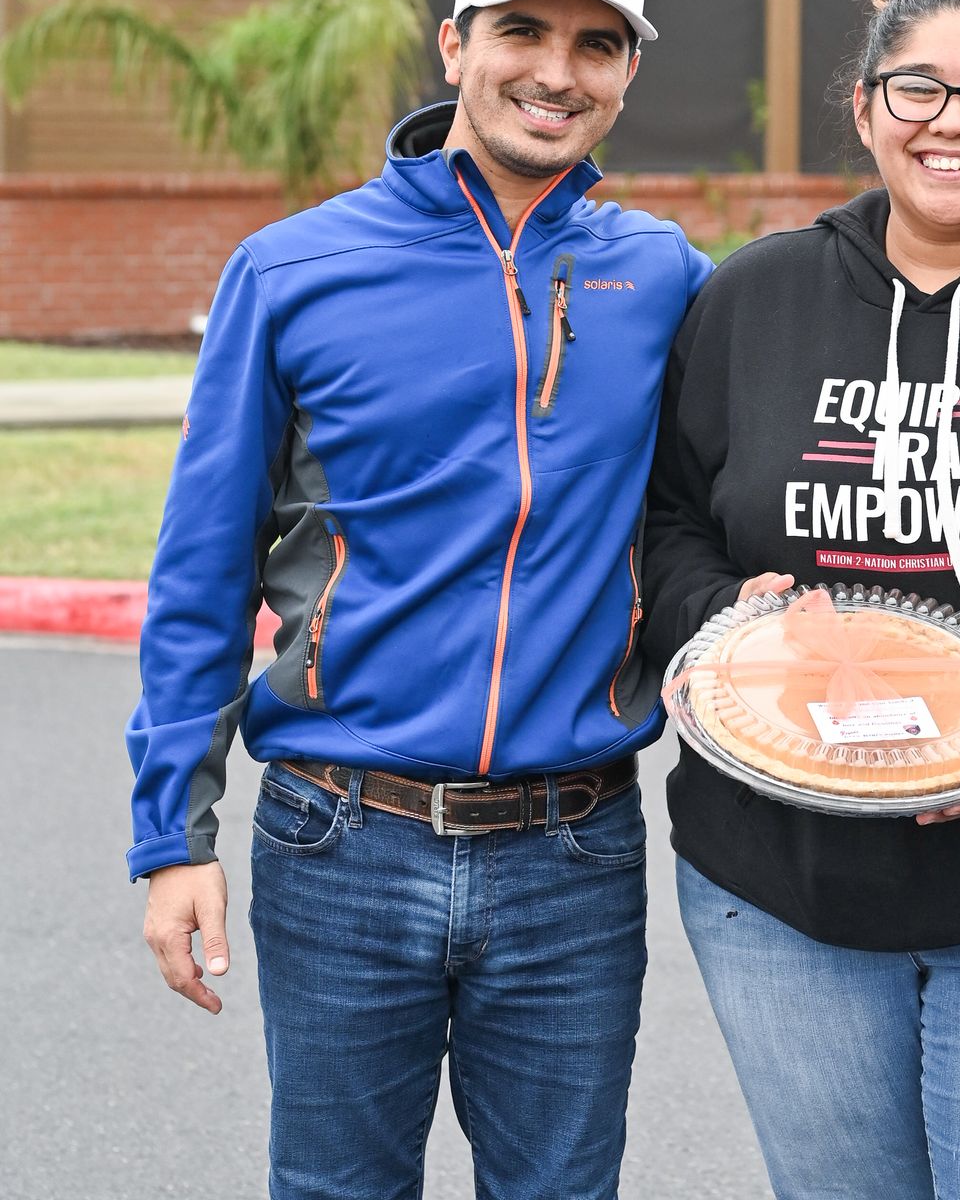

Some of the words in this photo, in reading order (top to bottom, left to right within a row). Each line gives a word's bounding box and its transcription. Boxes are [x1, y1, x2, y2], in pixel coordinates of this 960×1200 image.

[583, 278, 623, 290] solaris
[813, 378, 960, 433] EQUIP
[899, 557, 945, 569] CHRISTIAN
